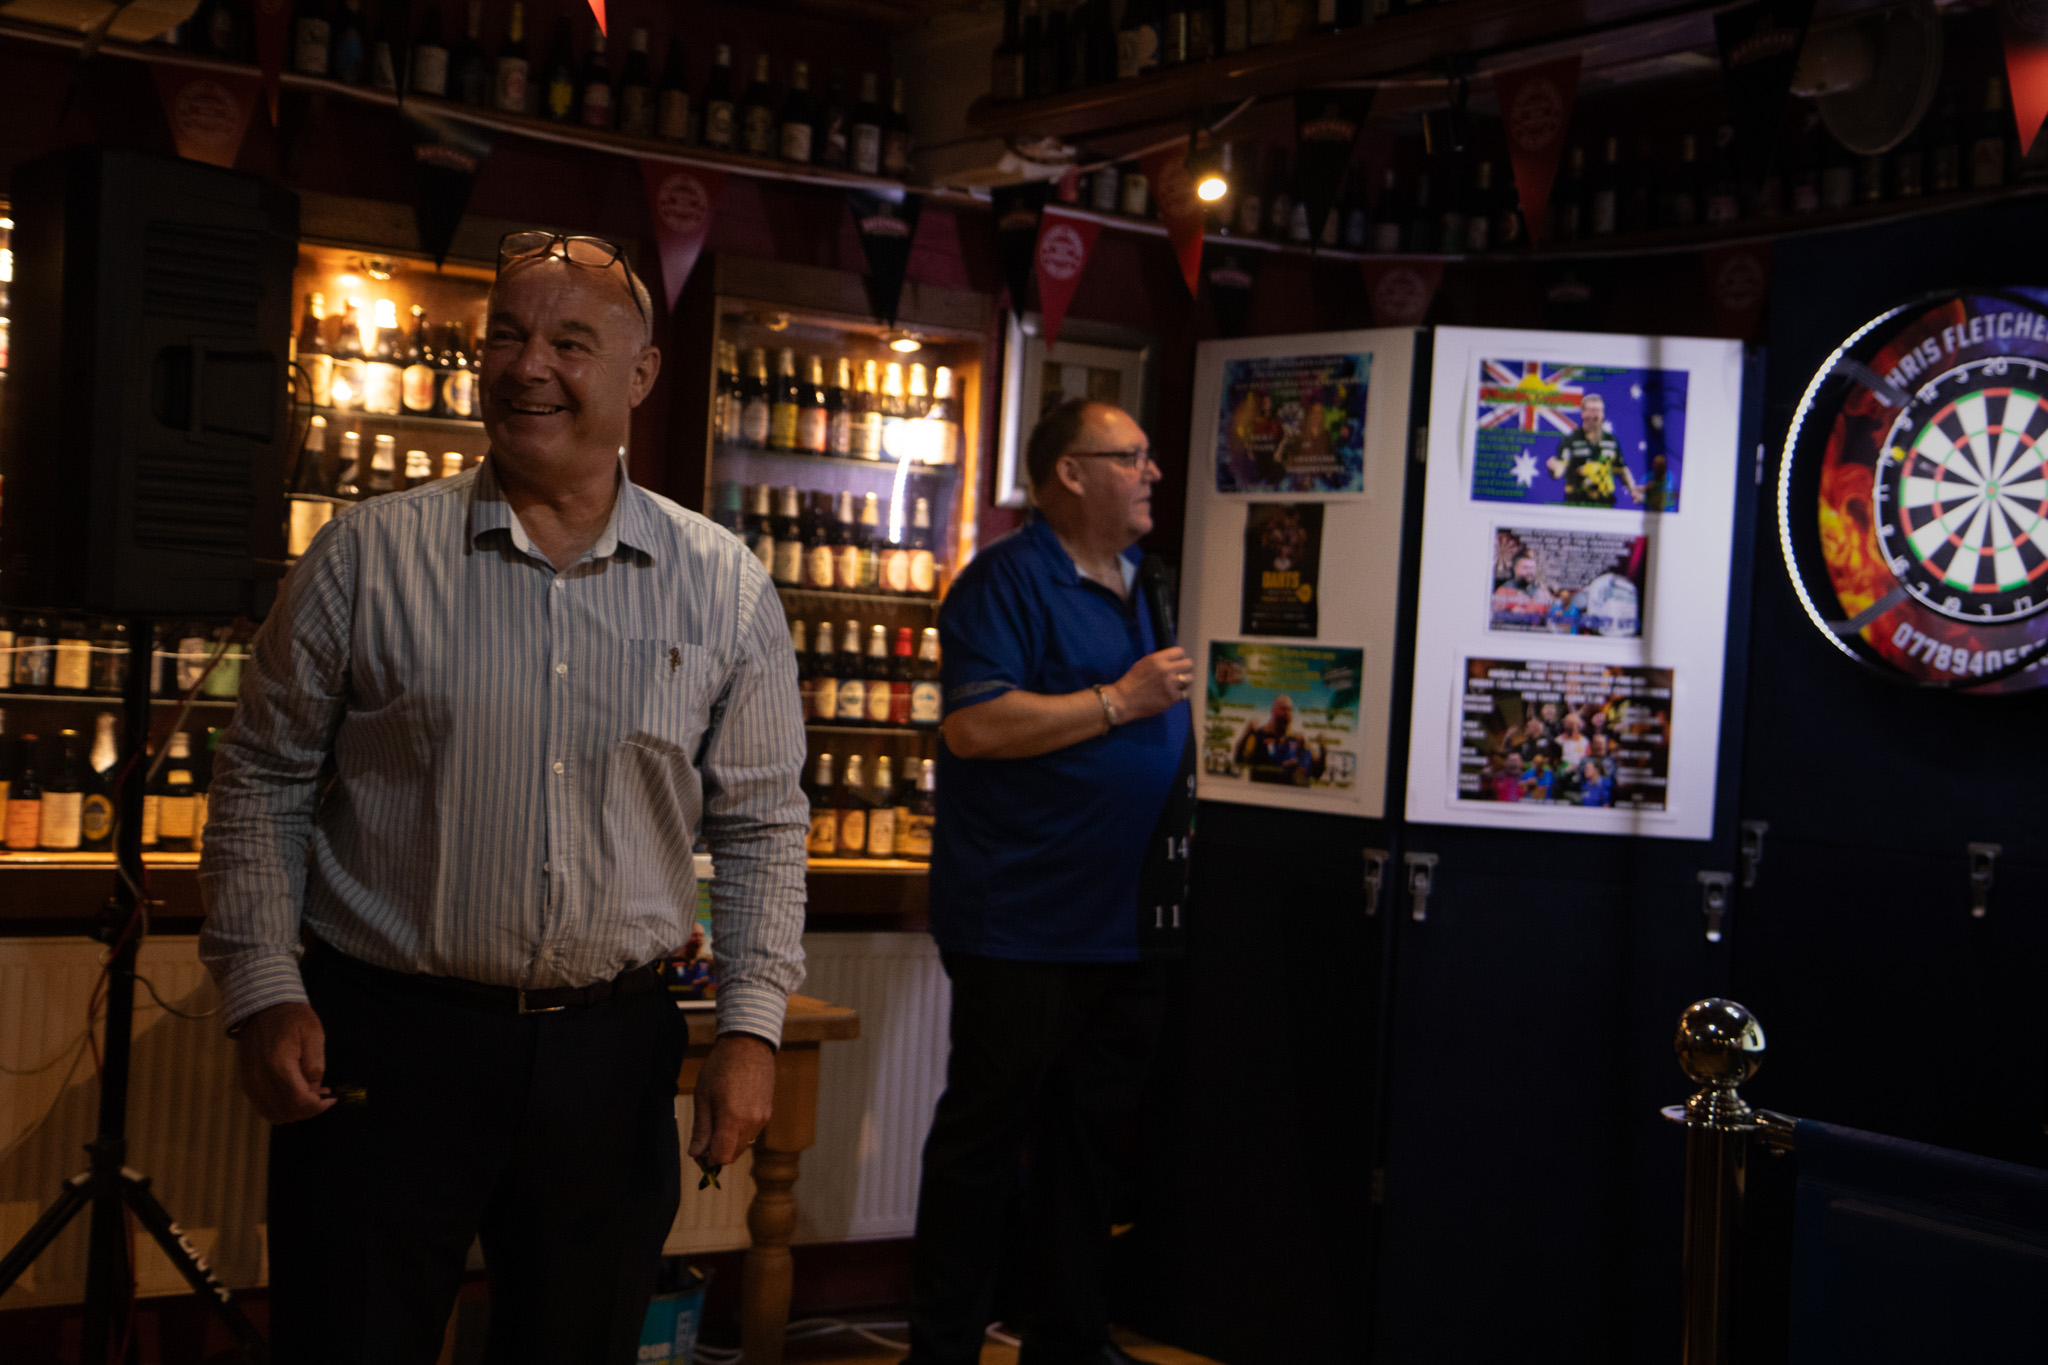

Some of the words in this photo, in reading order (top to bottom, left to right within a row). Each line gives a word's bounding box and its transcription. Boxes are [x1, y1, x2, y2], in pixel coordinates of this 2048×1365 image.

[1942, 311, 2048, 354] FLETCHE
[1165, 835, 1191, 862] 14
[1153, 904, 1182, 929] 11
